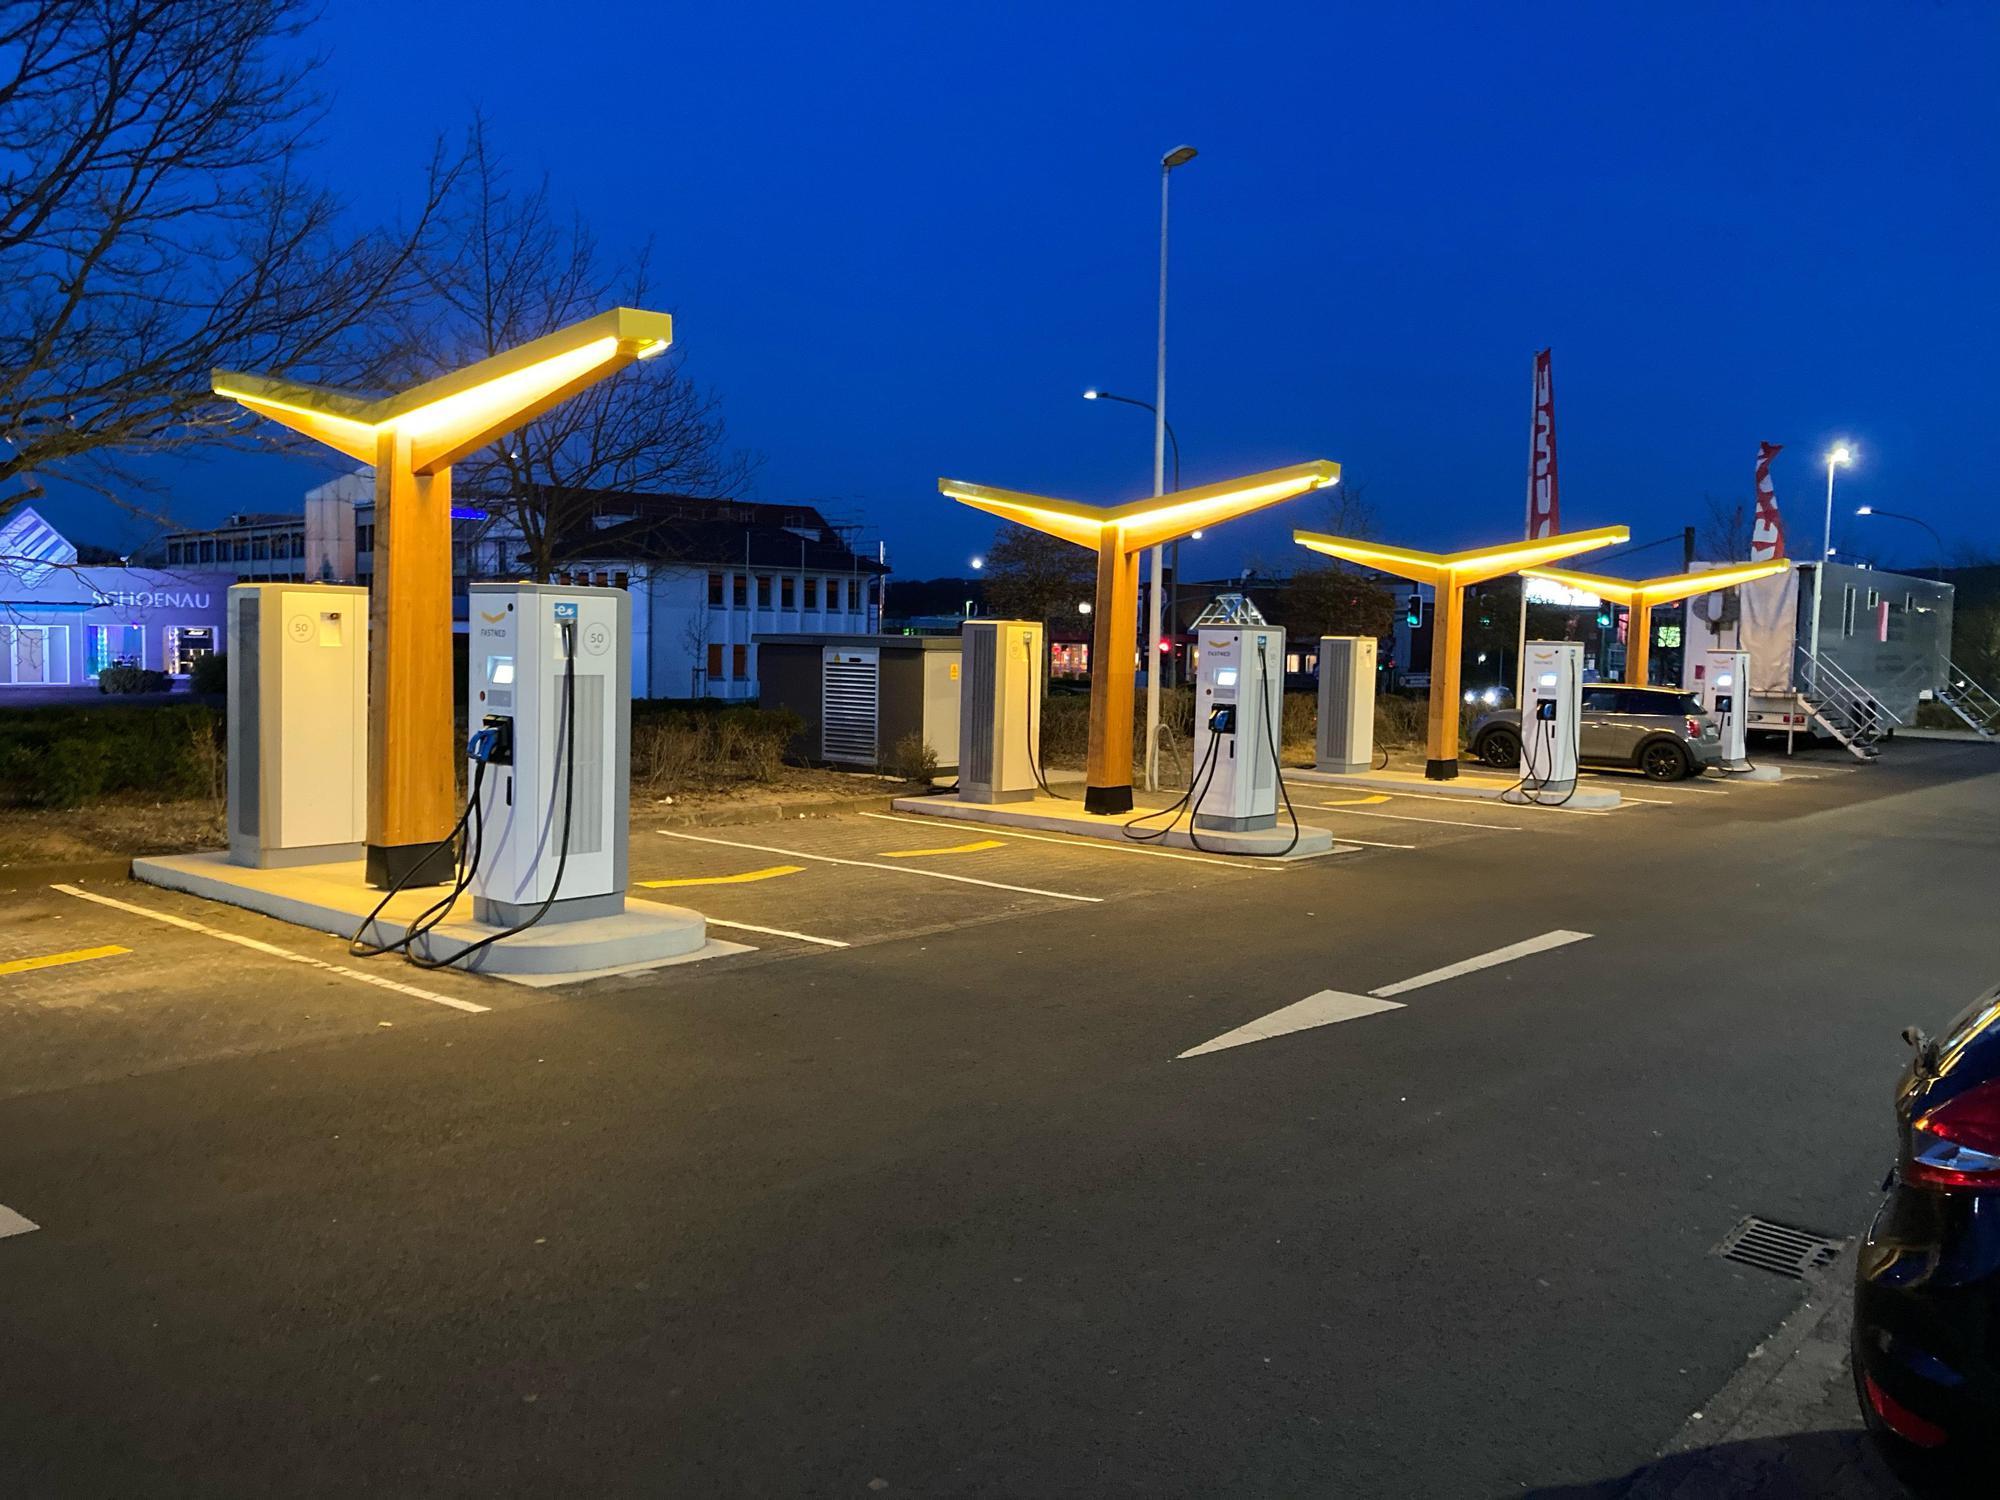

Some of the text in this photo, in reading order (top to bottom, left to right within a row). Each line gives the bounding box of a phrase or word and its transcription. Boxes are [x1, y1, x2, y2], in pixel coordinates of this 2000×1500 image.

[92, 590, 210, 609] SCHOENAU
[295, 623, 308, 633] 50
[480, 628, 506, 638] FASTNED
[590, 633, 604, 644] 50
